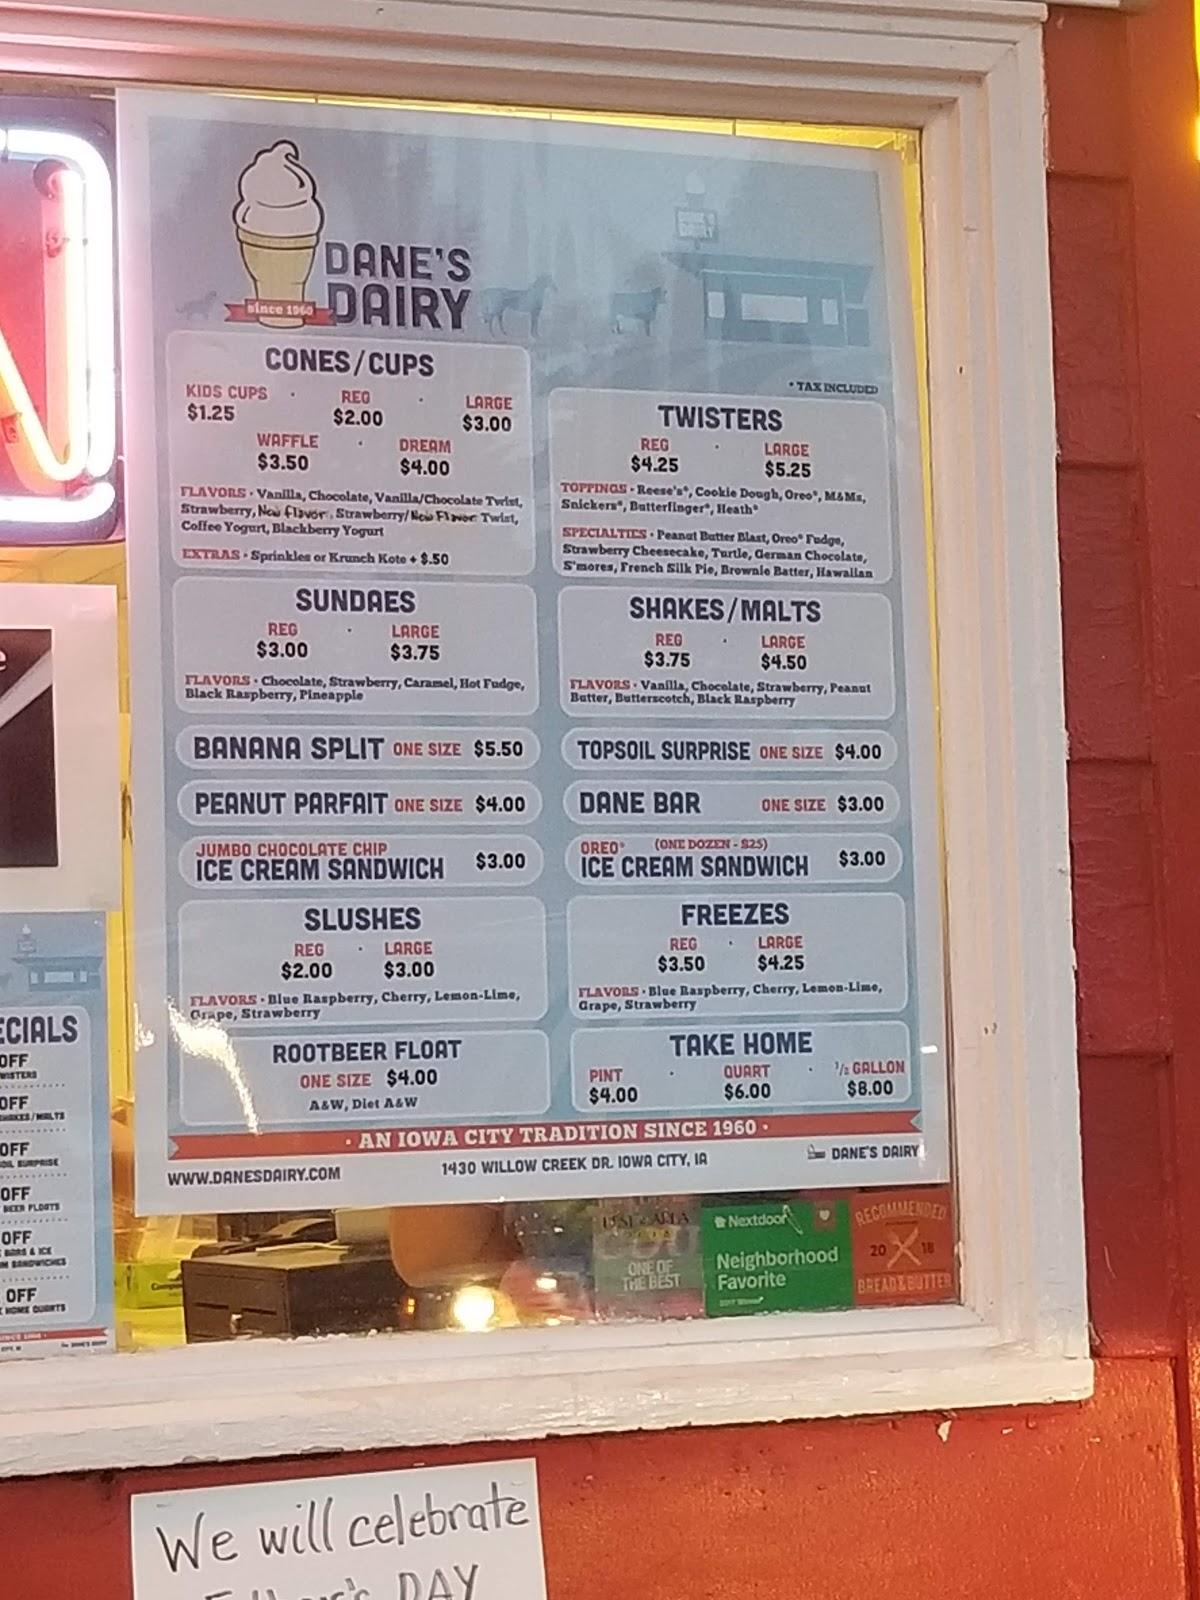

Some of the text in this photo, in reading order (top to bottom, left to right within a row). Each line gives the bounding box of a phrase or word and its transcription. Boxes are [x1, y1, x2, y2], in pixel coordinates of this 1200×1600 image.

[325, 242, 470, 282] DANE'S
[248, 302, 283, 315] since
[328, 283, 471, 329] DAIRY
[265, 348, 434, 377] CONES/CUPS
[186, 384, 267, 400] KIDS CUPS
[797, 382, 878, 394] TAX INCLUDED
[466, 396, 512, 410] LARGE
[187, 405, 235, 421] $1.25
[334, 409, 383, 427] $2.00
[658, 405, 782, 431] TWISTERS
[463, 415, 512, 432] $3.00
[257, 434, 318, 448] WAFFLE
[400, 439, 451, 453] DREAM
[641, 438, 669, 451] REG
[765, 443, 809, 457] LARGE
[258, 454, 309, 471] $3.50
[400, 459, 449, 476] $4.00
[631, 456, 678, 473] $4.25
[765, 461, 811, 478] $5.25
[181, 487, 246, 498] FLAVORS
[561, 483, 782, 501] TOPPINGS Cookie Dough,
[272, 523, 339, 538] Blackberry
[563, 528, 647, 539] SPECIALTIES
[183, 548, 375, 565] EXTRAS Sprinkles Krunch
[633, 546, 802, 560] Cheesecake, German
[563, 561, 873, 578] S'mores, Hawaiian
[296, 588, 416, 614] SUNDAES
[630, 596, 821, 623] SHAKES/MALTS
[268, 623, 298, 636] REG
[392, 625, 439, 639] LARGE
[655, 634, 682, 646] REG
[762, 636, 805, 649] LARGE
[257, 642, 308, 659] $3.00
[391, 644, 440, 661] $3.75
[644, 651, 690, 668] $3.75
[761, 654, 806, 670] $4.50
[185, 674, 457, 690] FLAVORS Chocolate, Strawberry, Caramel,
[570, 679, 870, 695] FLAVORS Chocolate, Strawberry, Peanut
[615, 693, 694, 705] Butterscotch,
[194, 736, 523, 760] BANANA SPLIT ONE SIZE $5.50
[577, 741, 881, 760] TOPSOIL SURPRISE ONE SIZE $4.00
[196, 792, 525, 815] PEANUT PARFAIT ONE SIZE $4.00
[580, 792, 884, 813] DANE BAR ONE SIZE $3.00
[196, 843, 387, 857] JUMBO CHOCOLATE CHIP
[655, 839, 685, 851] (ONE
[688, 839, 730, 850] DOZEN
[476, 852, 525, 870] $3.00
[581, 855, 808, 878] ICE CREAM SANDWICH
[839, 851, 885, 867] $3.00
[197, 857, 443, 881] ICE CREAM SANDWICH
[304, 907, 421, 932] SLUSHES
[682, 903, 790, 926] FREEZES
[294, 944, 324, 956] REG
[385, 942, 432, 956] LARGE
[670, 938, 697, 951] REG
[758, 936, 803, 949] LARGE
[281, 962, 332, 980] $2.00
[384, 961, 434, 979] $3.00
[658, 956, 705, 973] $3.50
[758, 954, 804, 971] $4.25
[190, 994, 257, 1007] FLAVORS
[578, 987, 639, 997] FLAVORS
[241, 1006, 320, 1021] Strawberry
[625, 999, 697, 1012] Strawberry
[272, 1040, 462, 1064] ROOTBEER FLOAT
[670, 1031, 812, 1056] TAKE HOME
[589, 1068, 623, 1082] PINT
[724, 1065, 770, 1079] QUART
[853, 1061, 905, 1075] GALLON
[300, 1069, 438, 1089] ONE SIZE $4.00
[589, 1087, 638, 1104] $4.00
[724, 1083, 771, 1100] $6.00
[847, 1080, 893, 1097] $8.00
[359, 1120, 757, 1150] AN IOWA CITY TRADITION SINCE 1960
[832, 1144, 920, 1160] DANE'S DAIRY
[442, 1153, 708, 1176] 1430 WILLOW CREEK DR. IOWA CITY, IA
[168, 1167, 341, 1186] WWW.DANESDAIRY.COM
[1, 1187, 30, 1201] OFF
[729, 1214, 787, 1228] Nextdoor
[2, 1231, 32, 1245] OFF
[717, 1246, 838, 1271] Neighborhood
[870, 1245, 886, 1256] 20
[628, 1260, 672, 1276] ONE OF
[623, 1274, 680, 1291] THE BEST
[718, 1271, 786, 1290] Favorite
[6, 1288, 37, 1303] OFF
[156, 1482, 529, 1572] We will celebrate
